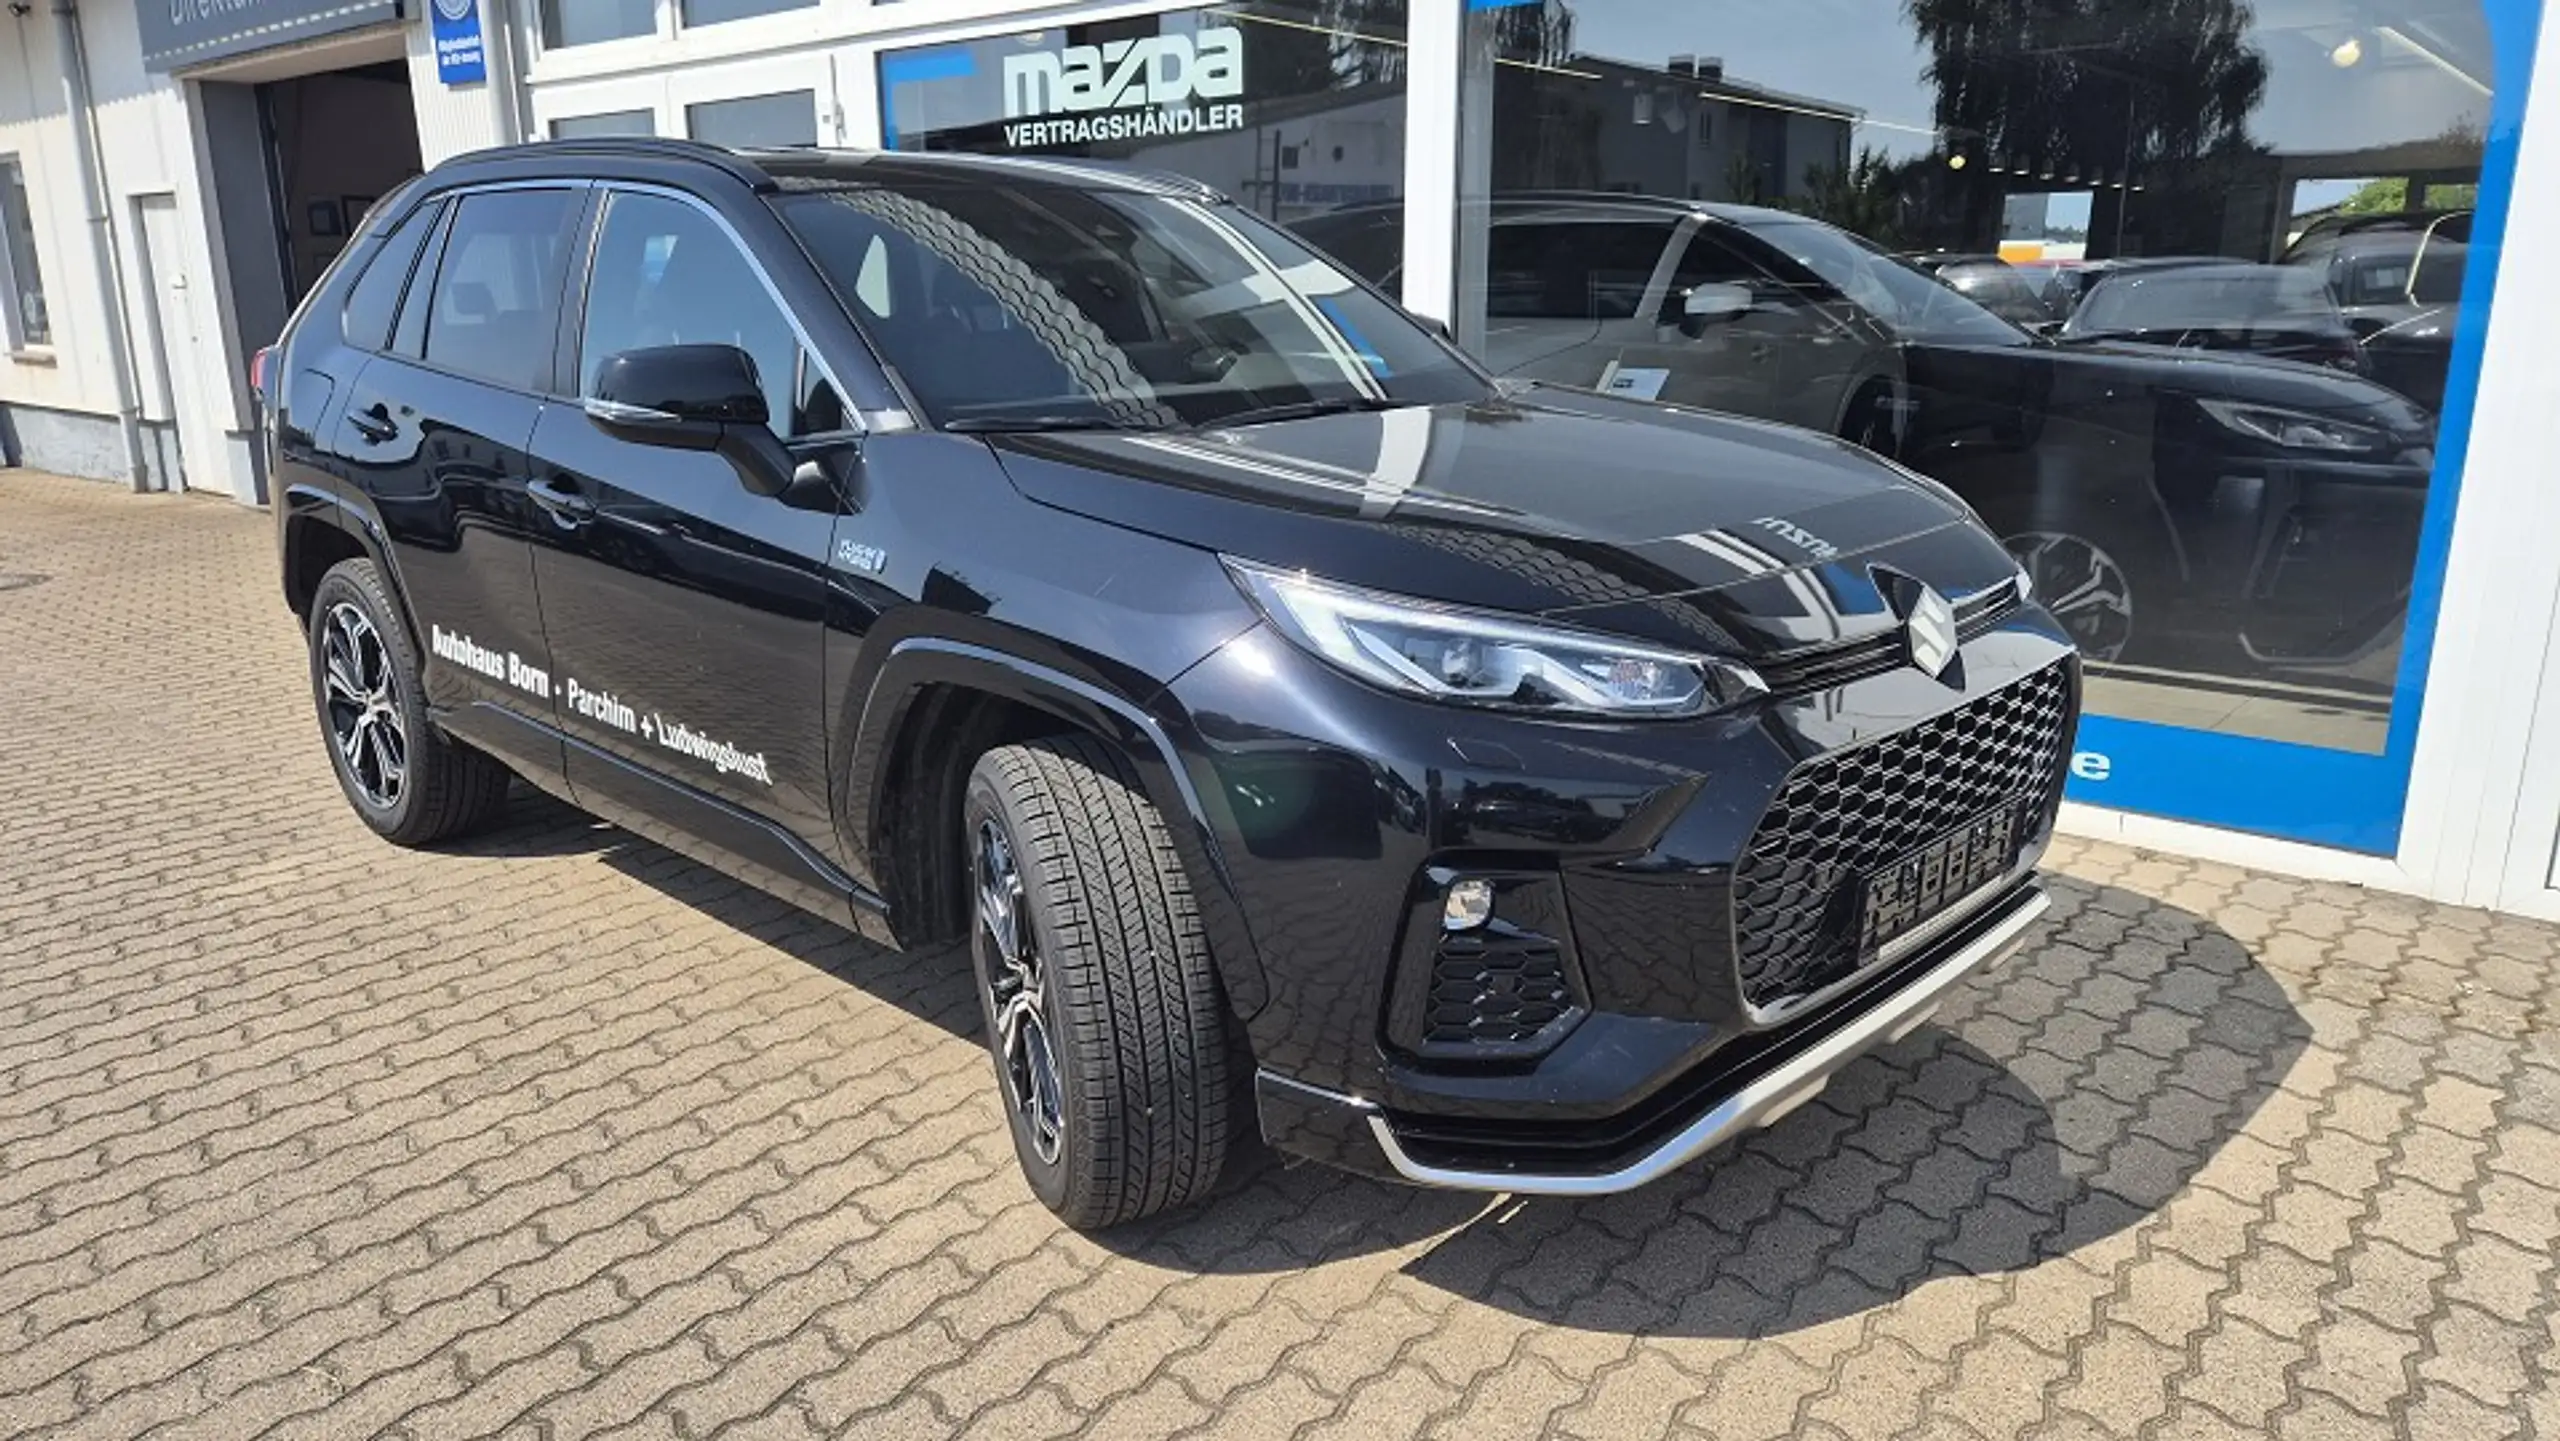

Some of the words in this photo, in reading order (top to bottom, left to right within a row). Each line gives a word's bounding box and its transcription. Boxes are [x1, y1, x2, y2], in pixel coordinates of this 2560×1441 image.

[1004, 104, 1243, 147] VERTRAGSHÄNDLER
[432, 623, 505, 681] Autohaus
[508, 651, 549, 698] Born
[567, 677, 636, 733] Parchim
[654, 712, 773, 786] Ludwigslust
